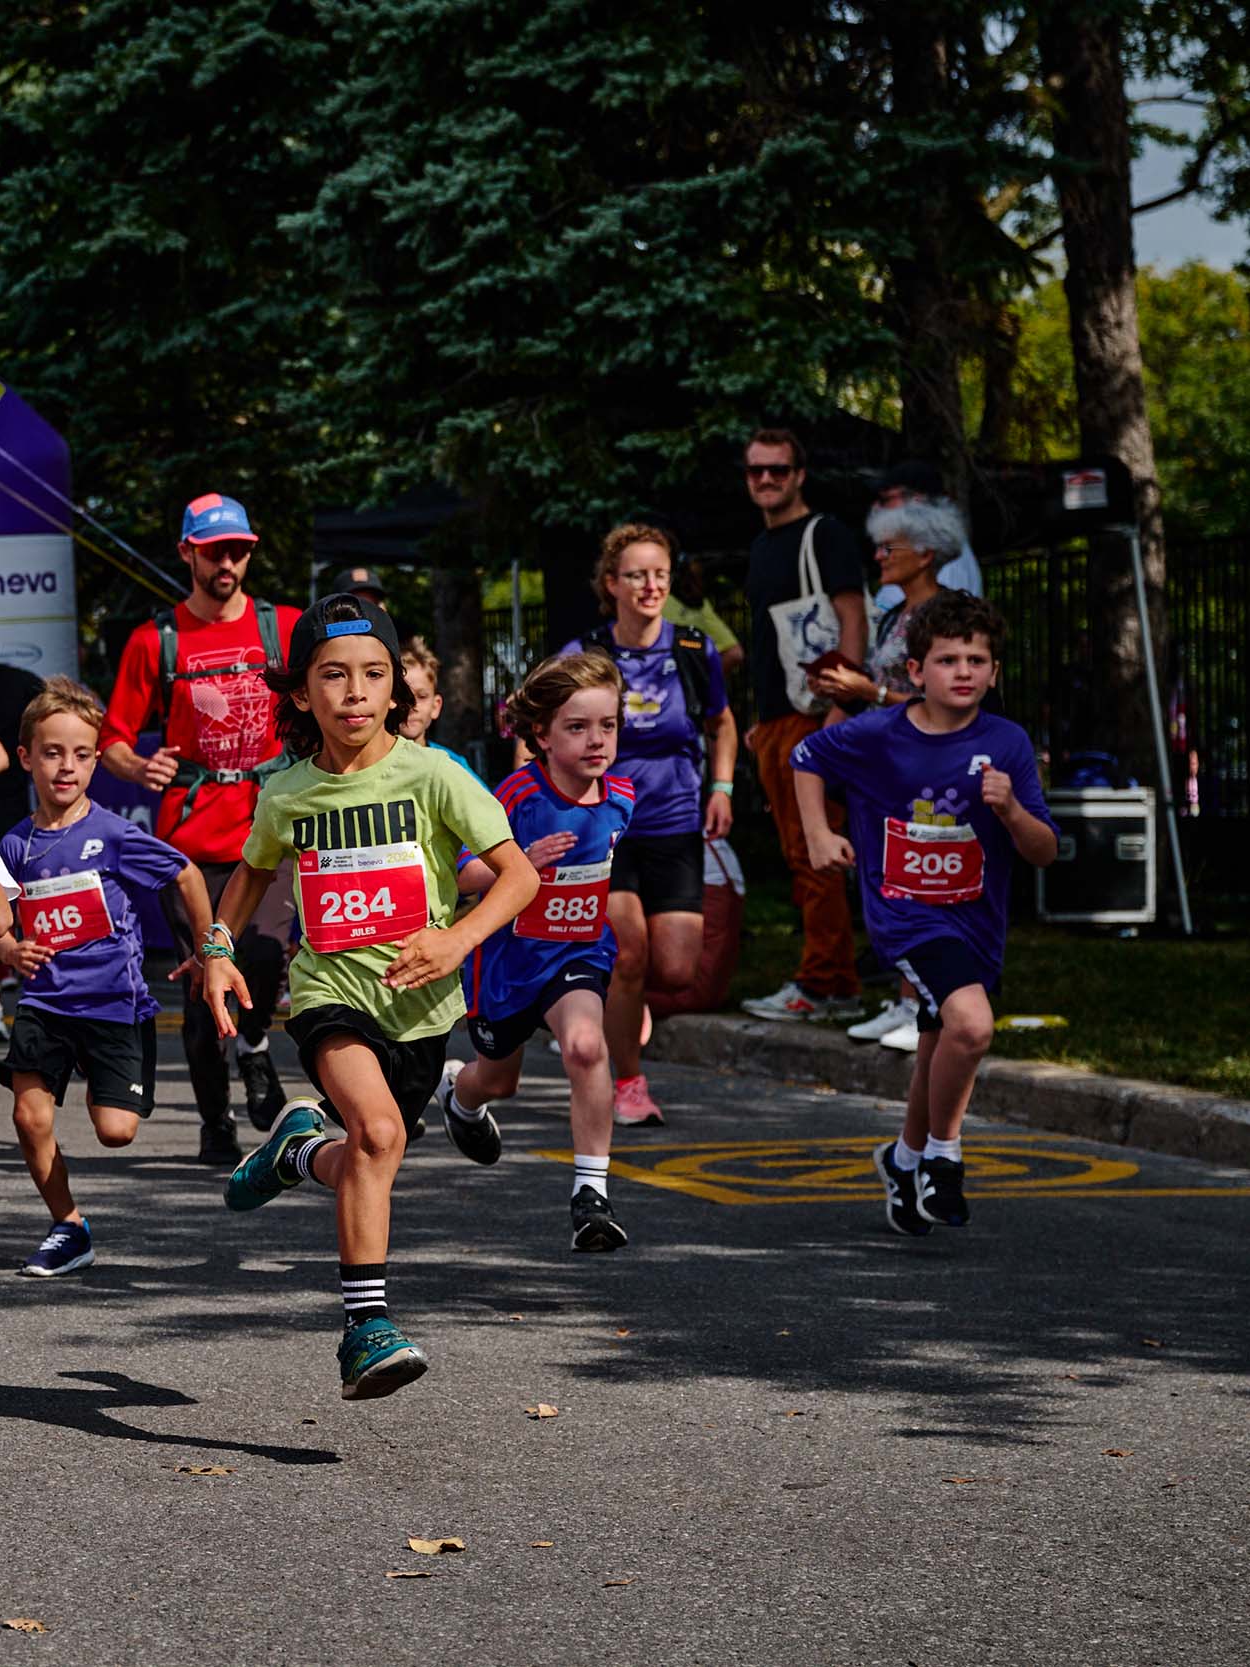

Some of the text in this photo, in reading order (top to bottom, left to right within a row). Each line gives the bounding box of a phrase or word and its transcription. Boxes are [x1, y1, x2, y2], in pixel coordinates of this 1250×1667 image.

[292, 799, 417, 851] PUMA
[903, 850, 963, 876] 206
[319, 887, 396, 924] 284
[544, 895, 598, 921] 883
[33, 905, 83, 934] 416
[350, 927, 376, 937] JULES
